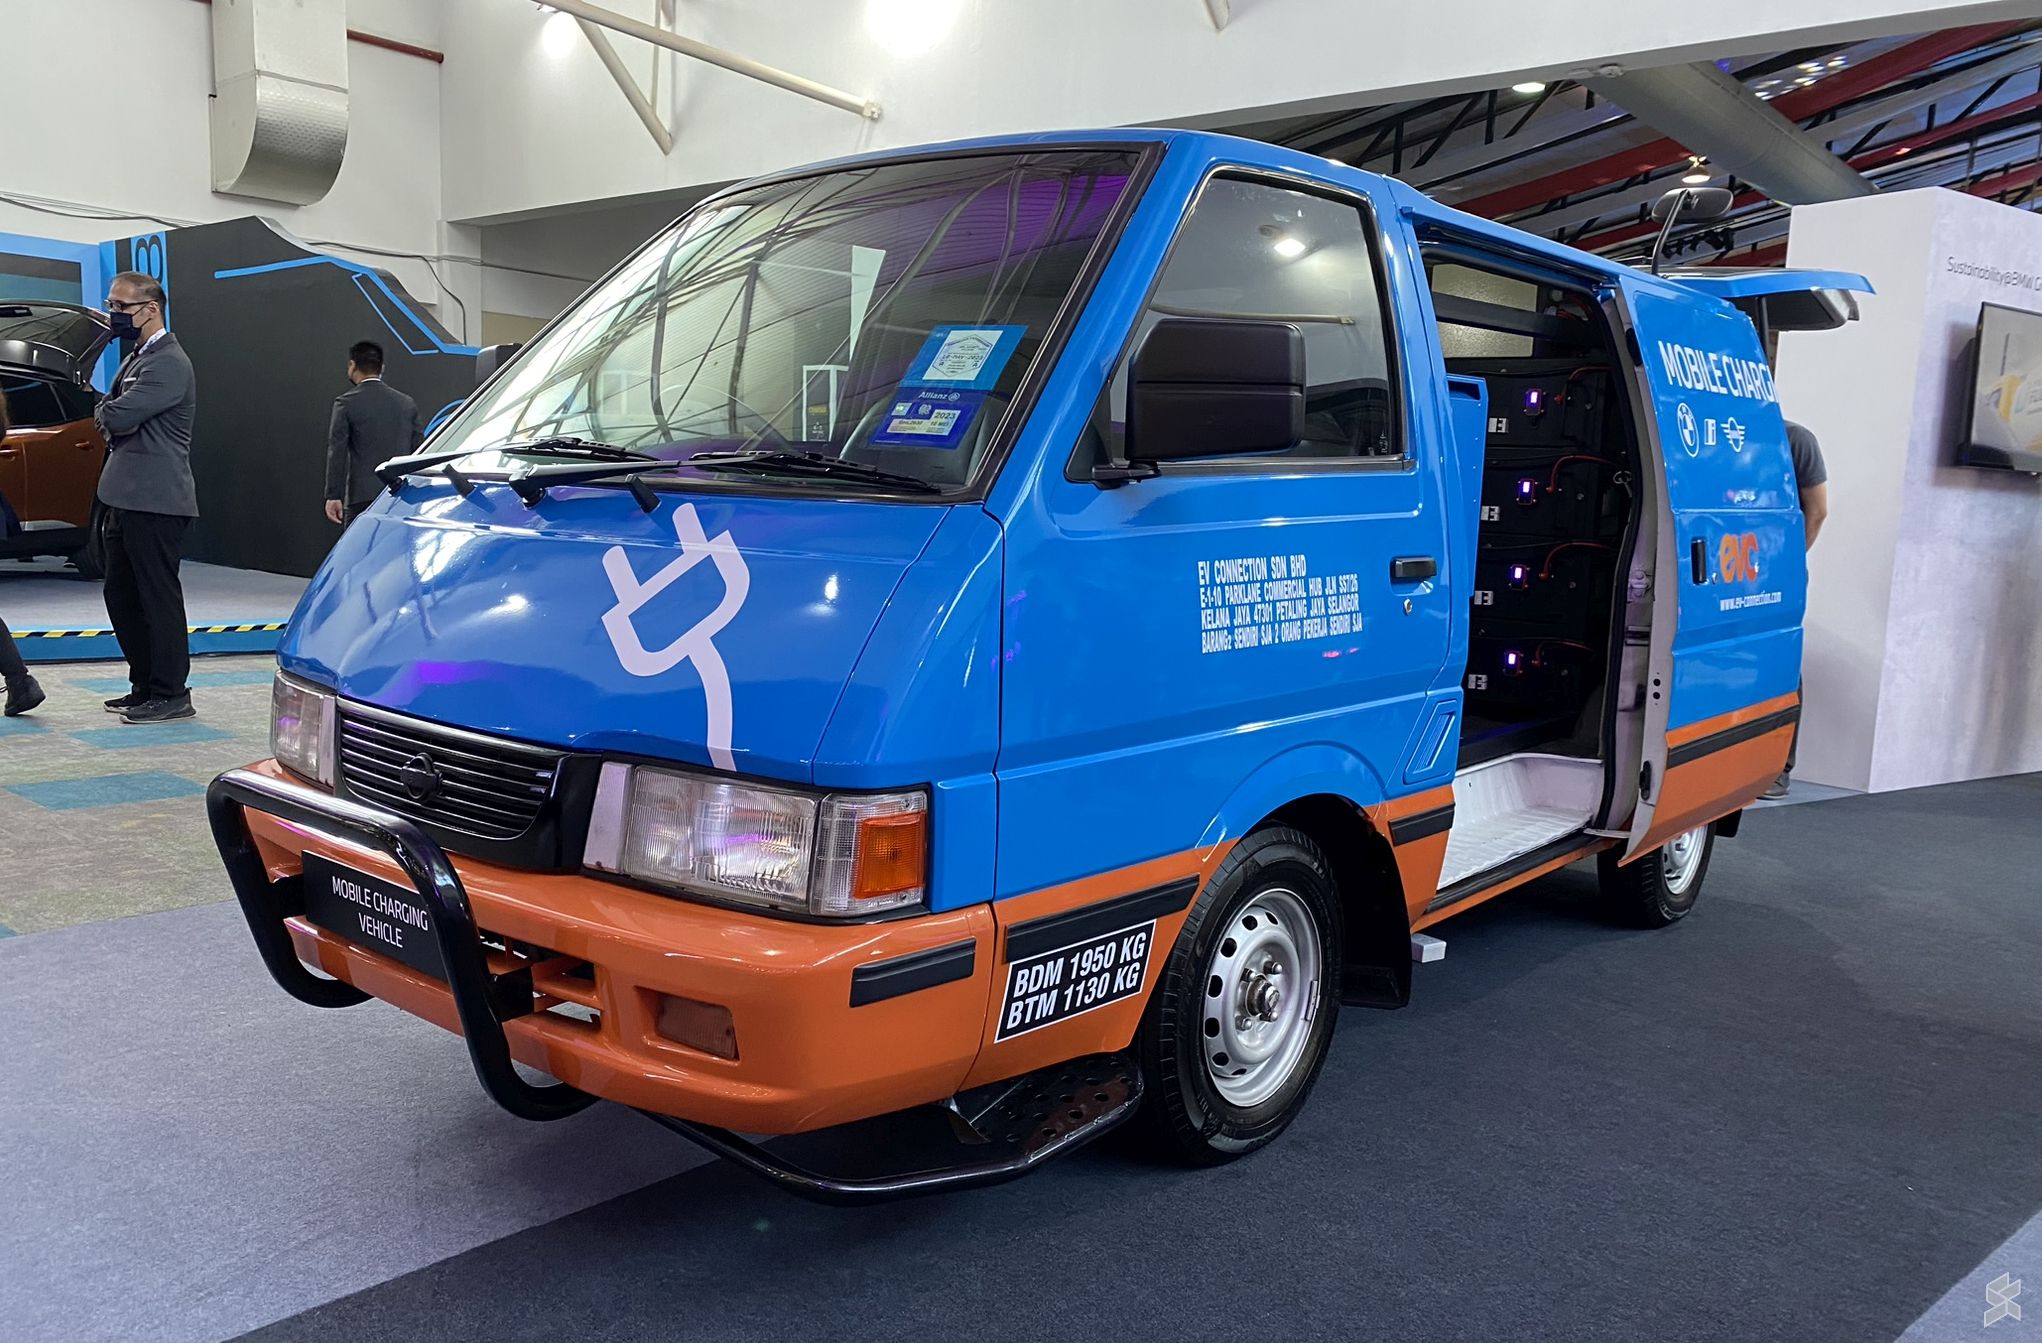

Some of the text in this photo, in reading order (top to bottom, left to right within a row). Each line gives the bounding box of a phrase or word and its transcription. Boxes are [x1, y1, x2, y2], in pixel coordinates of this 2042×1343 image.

[1658, 340, 1728, 394] MOBILE
[918, 391, 948, 400] Allianz
[1198, 554, 1307, 585] EV CONNECTION SDN BHD
[1720, 533, 1759, 584] evc
[1200, 586, 1222, 608] E-1-10
[1225, 583, 1262, 605] PARKLANE
[1264, 578, 1307, 601] COMMERCIAL
[1309, 577, 1323, 597] HUB
[1325, 576, 1337, 596] JLN
[1201, 593, 1360, 630] KELANA JAYA 47301 PETALING JAYA SELANGOR
[1274, 622, 1280, 644] 2
[1281, 620, 1301, 643] ORANG
[332, 876, 428, 931] MOBILE CHARGING
[358, 912, 403, 948] VEHICLE
[1013, 931, 1147, 998] BDM 1950 KG
[1006, 961, 1141, 1030] BTM 1130 KG
